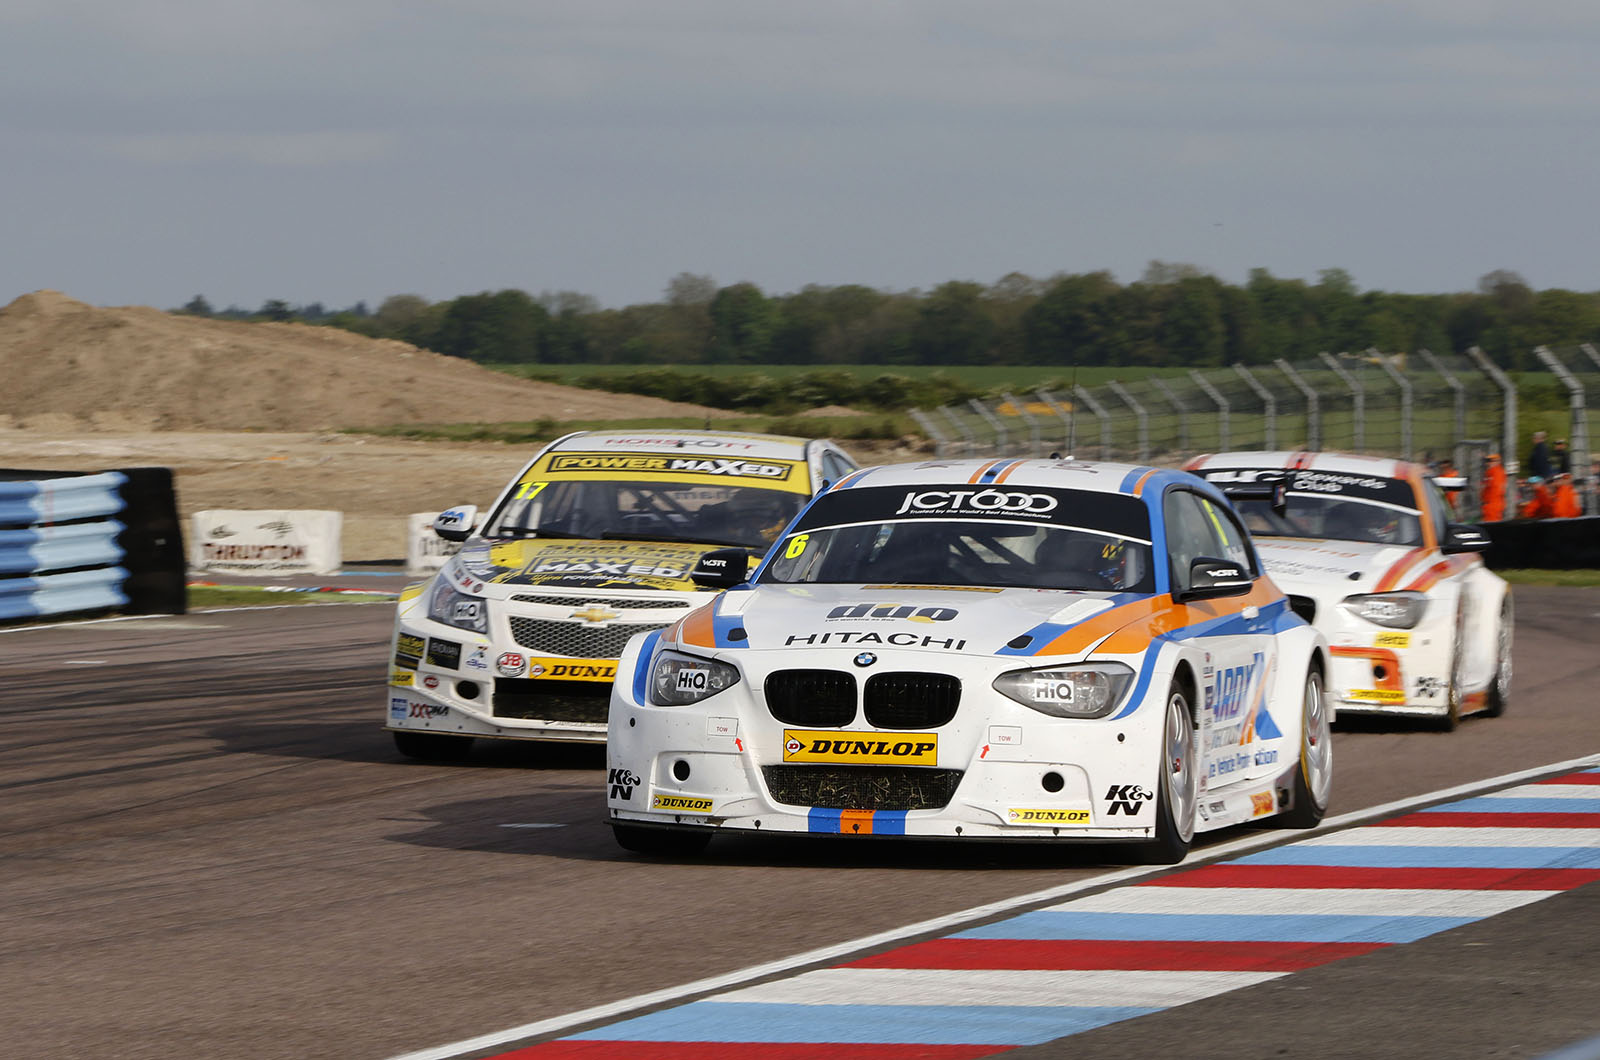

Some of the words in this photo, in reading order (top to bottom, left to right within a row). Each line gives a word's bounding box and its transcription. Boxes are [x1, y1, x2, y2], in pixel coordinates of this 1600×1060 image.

[559, 457, 666, 469] POWER
[671, 459, 782, 477] MAXED
[1293, 479, 1343, 492] Club
[1295, 471, 1388, 489] Rewards
[514, 482, 549, 500] 17
[896, 488, 1058, 515] JCT600
[785, 534, 810, 559] 6
[533, 562, 682, 577] MAXED
[703, 559, 727, 567] WSR
[826, 603, 959, 624] duo
[784, 632, 967, 651] HITACHI
[549, 665, 616, 678] DUNL
[677, 672, 707, 690] HiQ
[1036, 682, 1073, 701] HiQ
[808, 739, 936, 757] DUNLOP
[661, 797, 713, 809] DUNLOP
[1022, 811, 1089, 821] DUNLOP
